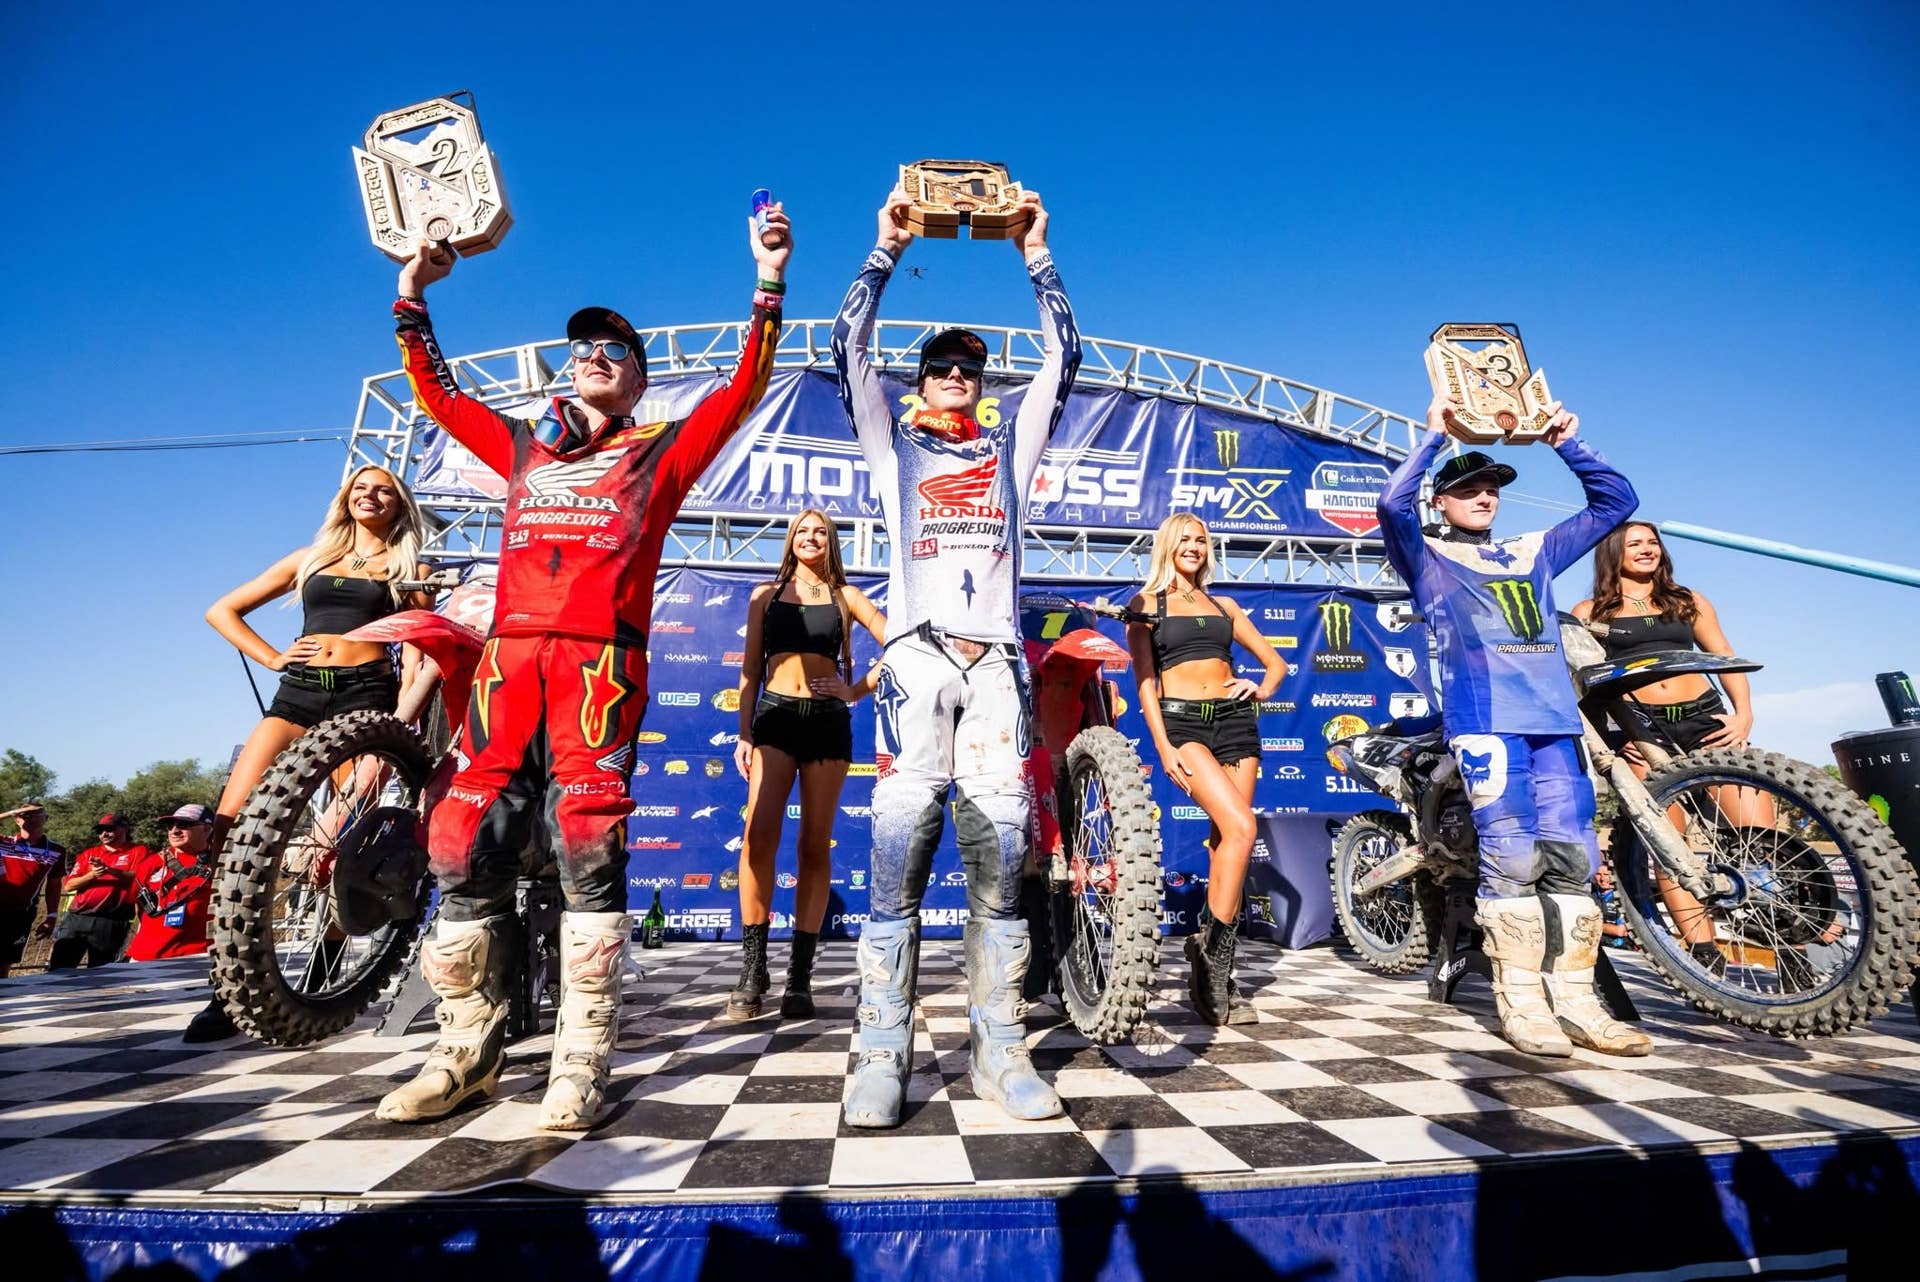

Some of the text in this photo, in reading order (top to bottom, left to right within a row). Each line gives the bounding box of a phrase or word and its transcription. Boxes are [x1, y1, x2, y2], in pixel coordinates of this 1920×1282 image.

[431, 138, 463, 178] 2
[1486, 354, 1518, 388] 3
[517, 495, 621, 513] HONDA
[1168, 477, 1284, 520] SMX
[515, 511, 614, 527] PROGRESSIVE
[919, 505, 1007, 522] HONDA
[920, 521, 1004, 538] PROGRESSIVE
[1209, 521, 1288, 531] CHAMPIONSHIP
[542, 533, 585, 541] DUNLOP
[1264, 608, 1285, 620] 5.11
[1041, 612, 1070, 639] 1
[1497, 643, 1557, 653] PROGRESSIVE
[1316, 654, 1364, 663] MONSTER
[659, 692, 700, 706] WPS
[1027, 775, 1042, 843] DUNLOP
[1448, 956, 1466, 976] UFO
